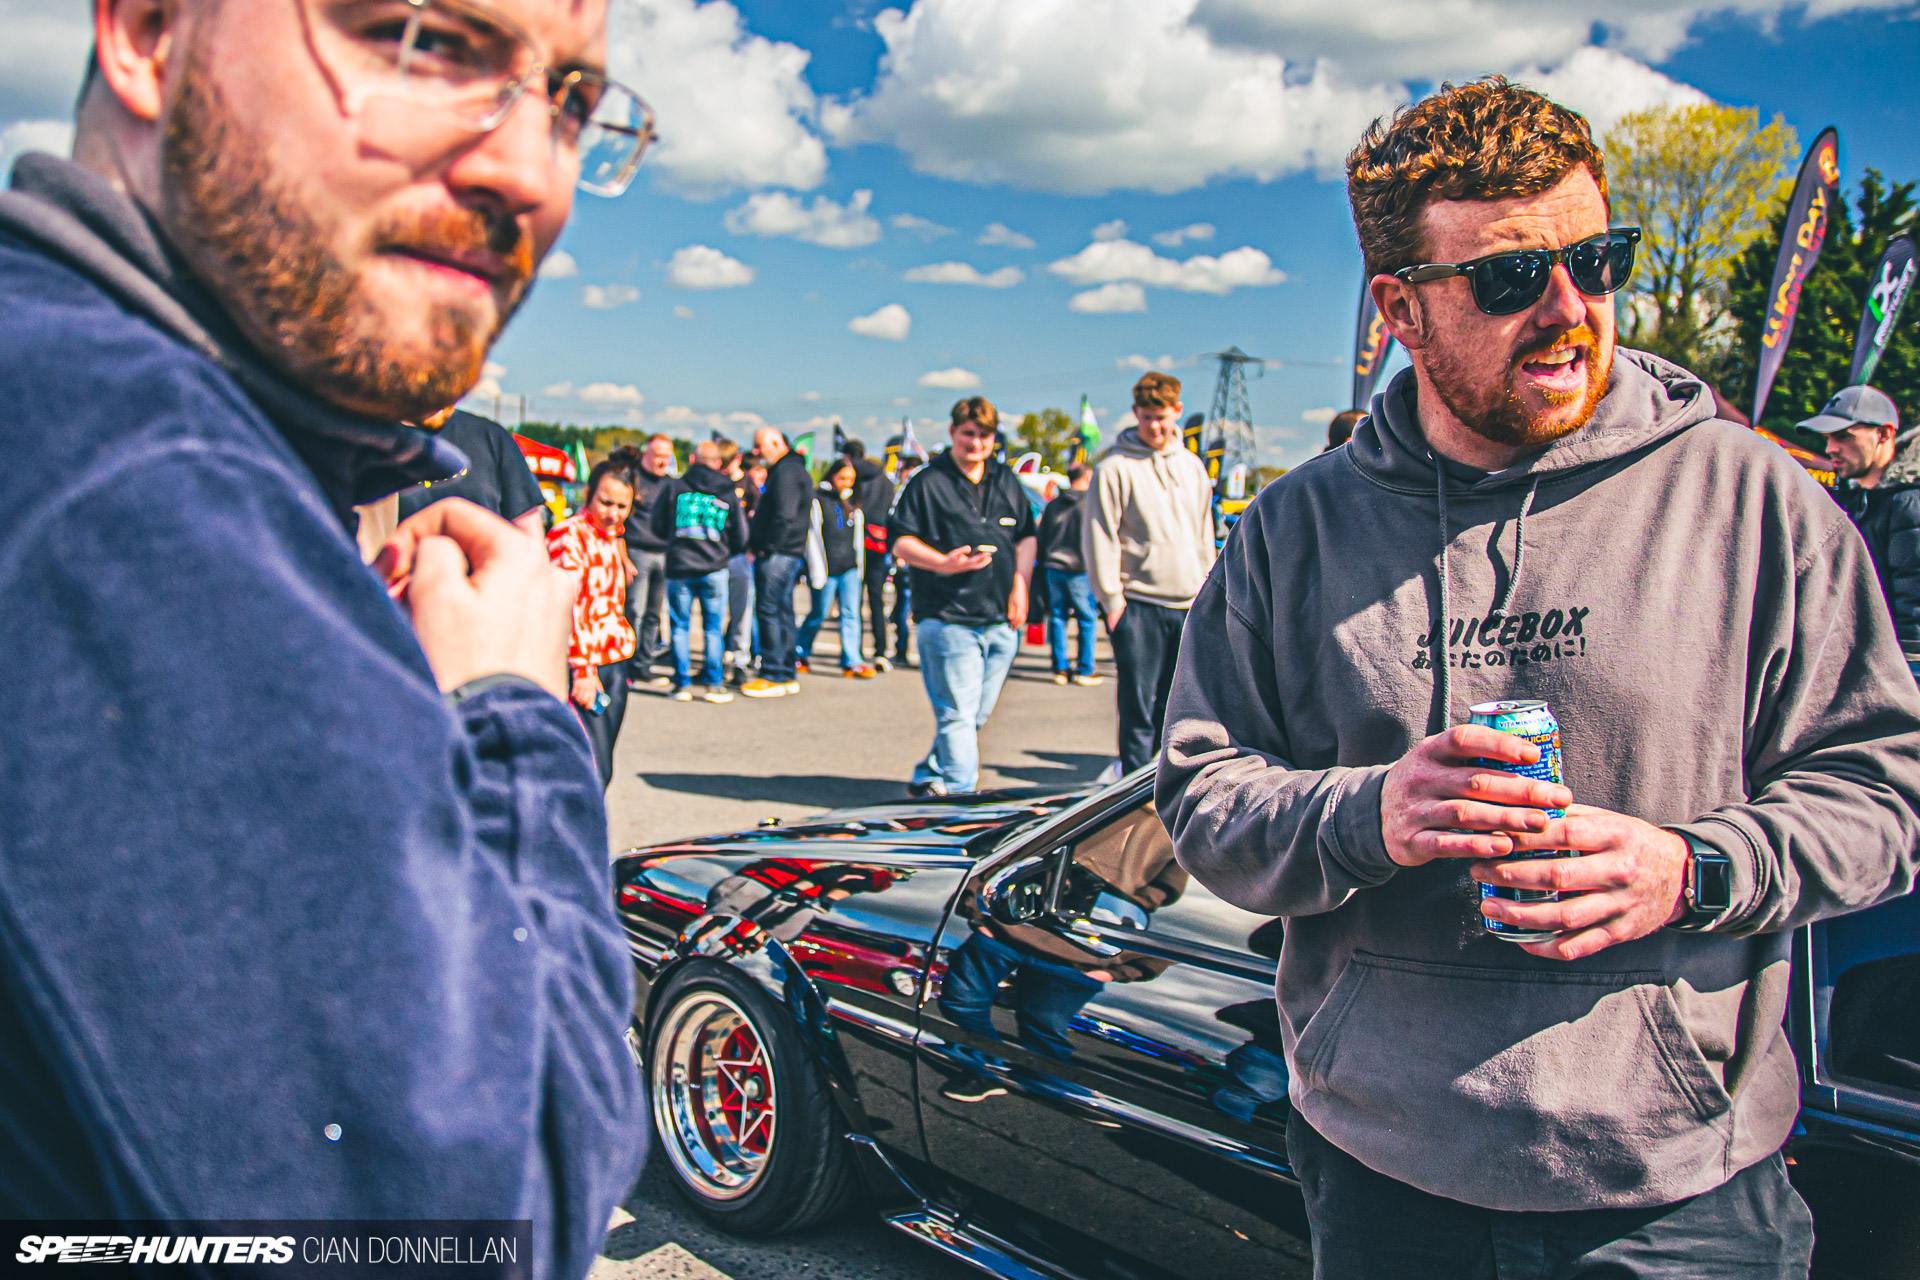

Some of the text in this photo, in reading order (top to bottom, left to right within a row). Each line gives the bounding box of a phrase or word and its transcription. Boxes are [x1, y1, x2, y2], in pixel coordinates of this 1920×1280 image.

[1416, 606, 1590, 648] JUICEBOX
[1411, 636, 1587, 670] あたのために!
